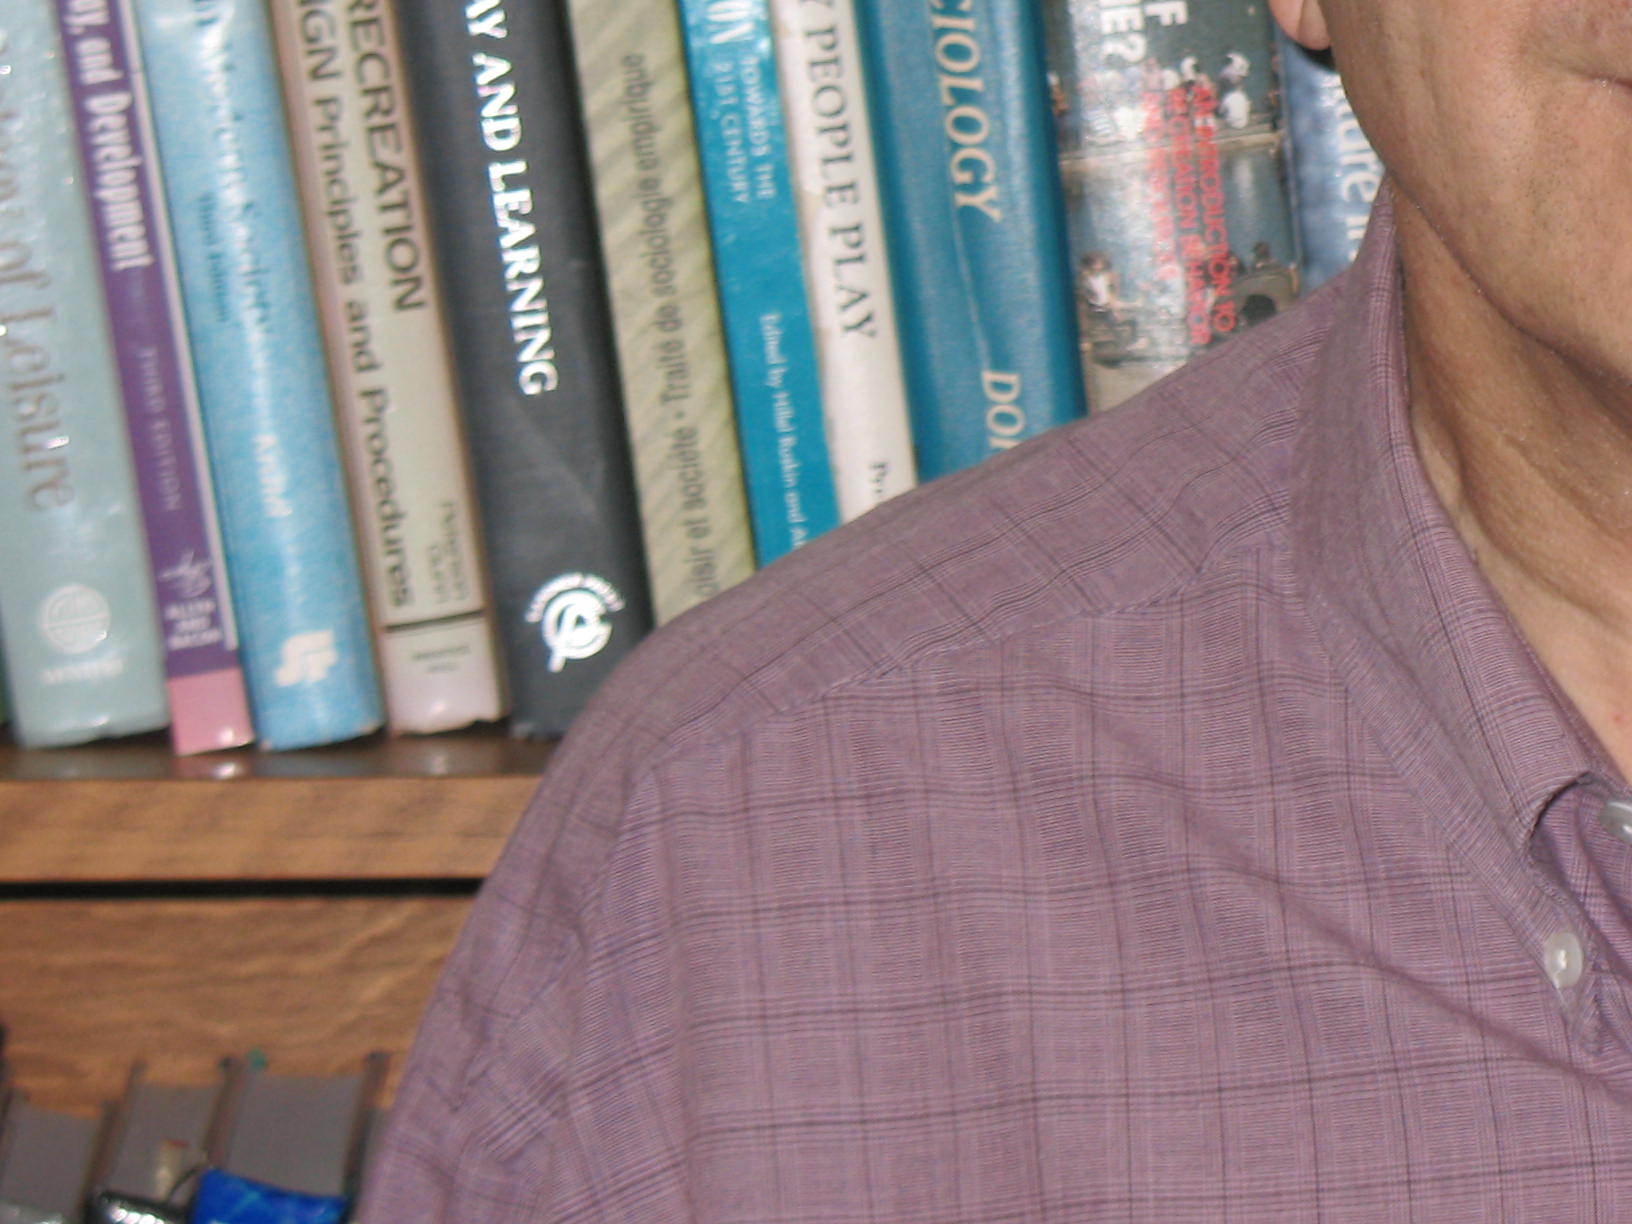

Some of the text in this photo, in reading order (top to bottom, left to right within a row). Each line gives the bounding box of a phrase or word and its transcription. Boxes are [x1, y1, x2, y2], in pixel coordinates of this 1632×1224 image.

[73, 33, 124, 85] and
[469, 47, 526, 155] AND
[612, 49, 665, 173] empirique
[732, 54, 777, 158] TOWARDS
[797, 23, 864, 210] PEOPLE
[80, 89, 157, 272] Development
[303, 91, 371, 286] Principles
[630, 173, 684, 298] sociologie
[338, 295, 384, 369] and
[485, 156, 563, 397] LEARNING
[651, 301, 683, 334] de
[825, 219, 881, 343] PLAY
[351, 386, 421, 608] Procedures
